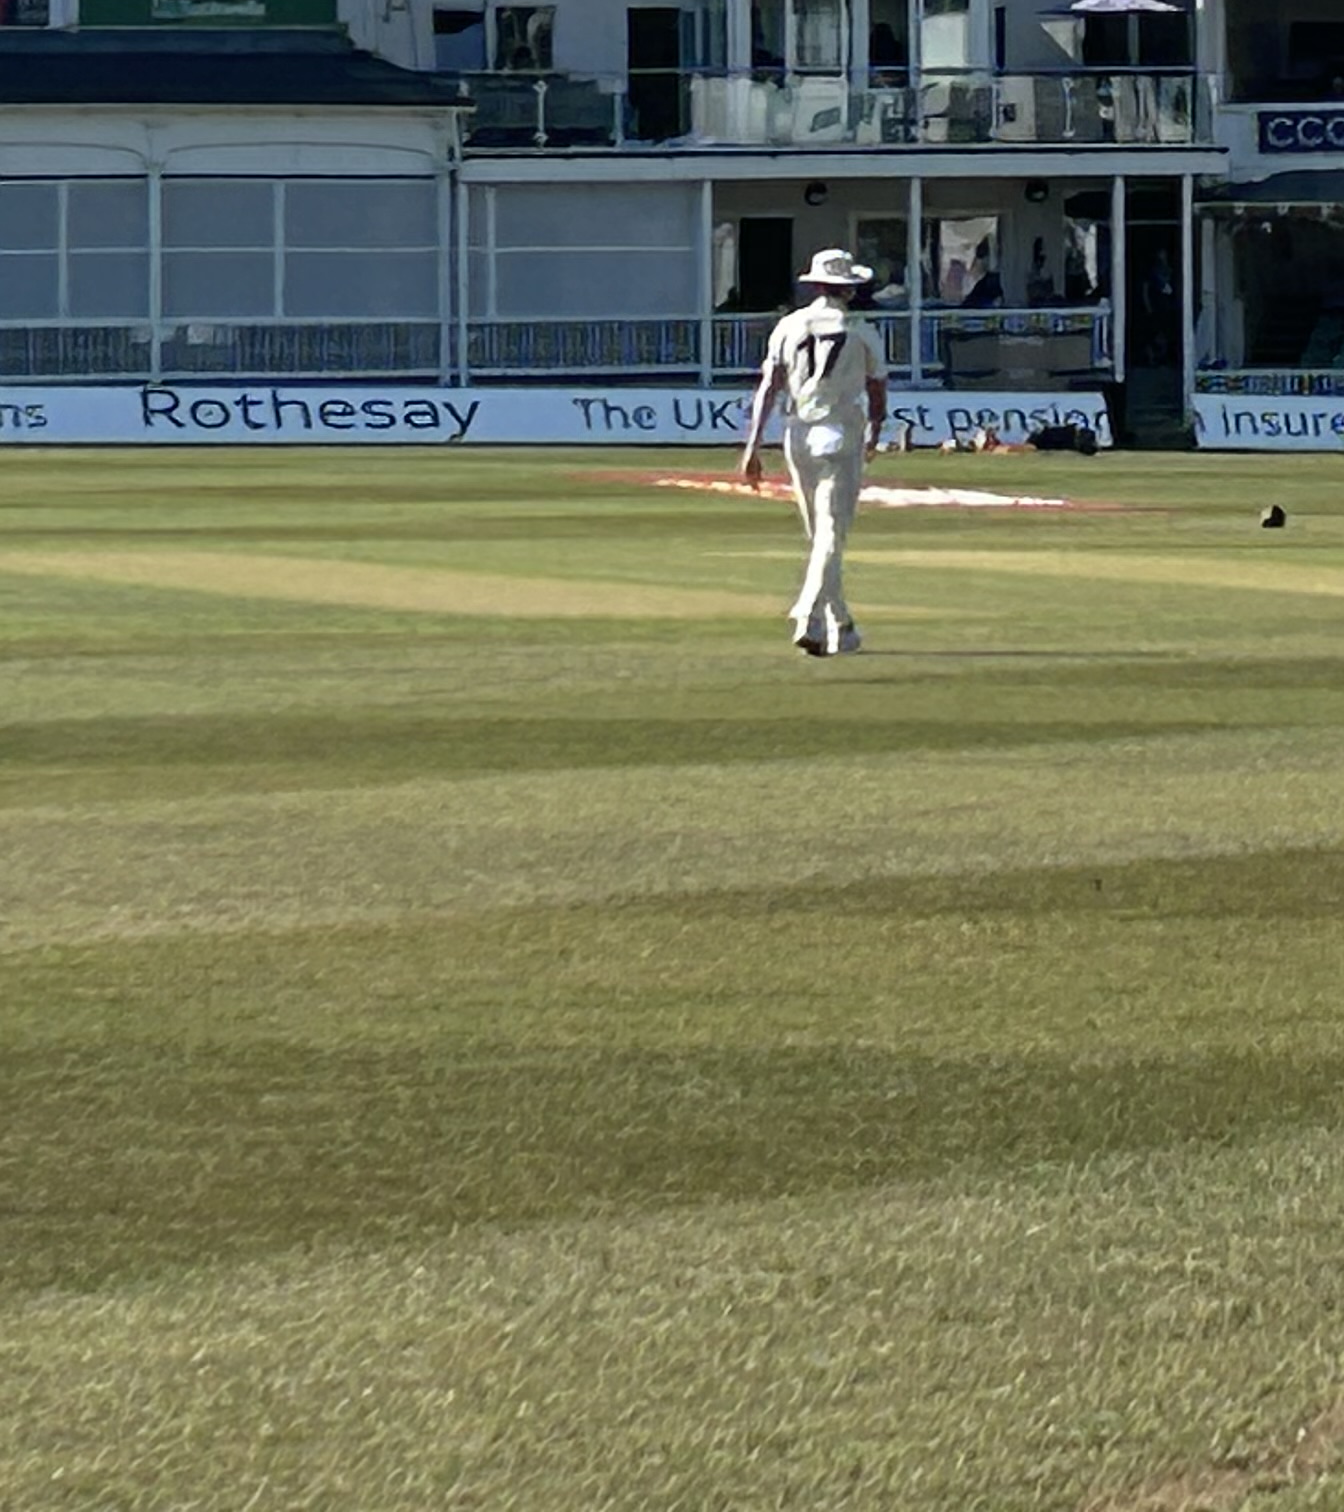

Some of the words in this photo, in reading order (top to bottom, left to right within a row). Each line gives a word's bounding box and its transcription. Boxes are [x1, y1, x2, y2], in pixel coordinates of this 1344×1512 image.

[797, 331, 847, 379] 17
[142, 389, 480, 441] Rothesay
[572, 398, 656, 431] The
